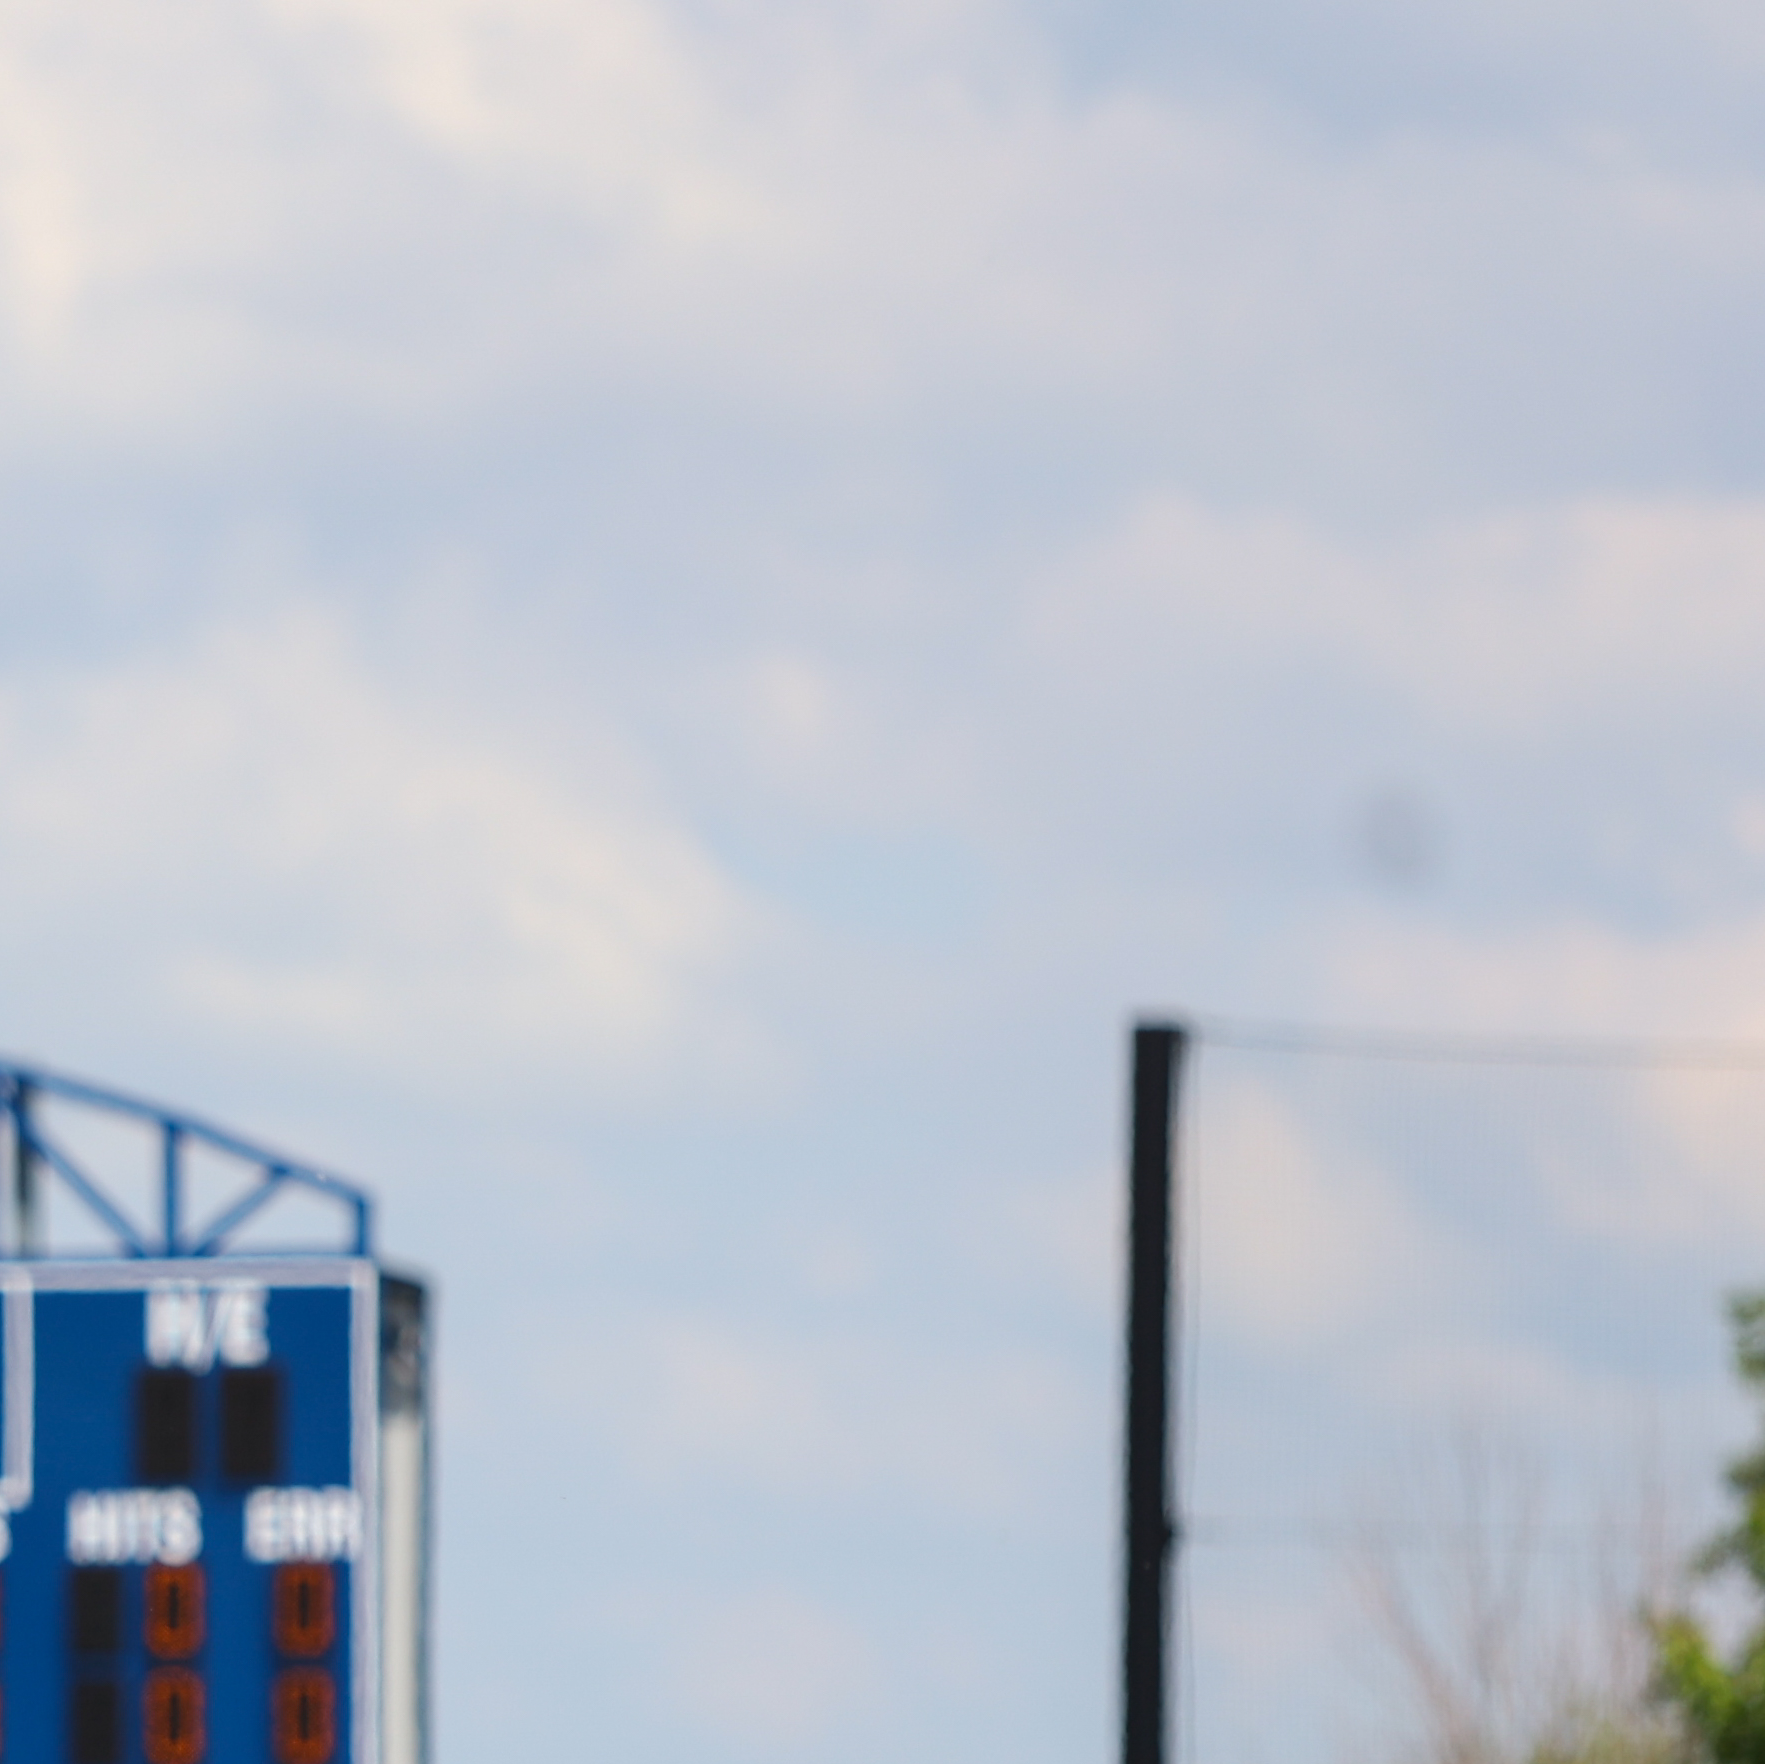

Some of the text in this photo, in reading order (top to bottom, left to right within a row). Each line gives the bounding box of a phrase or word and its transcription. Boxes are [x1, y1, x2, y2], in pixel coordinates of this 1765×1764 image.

[66, 1488, 202, 1566] HITS
[243, 1487, 364, 1564] ERR
[144, 1563, 205, 1660] 0
[274, 1561, 335, 1659] 0
